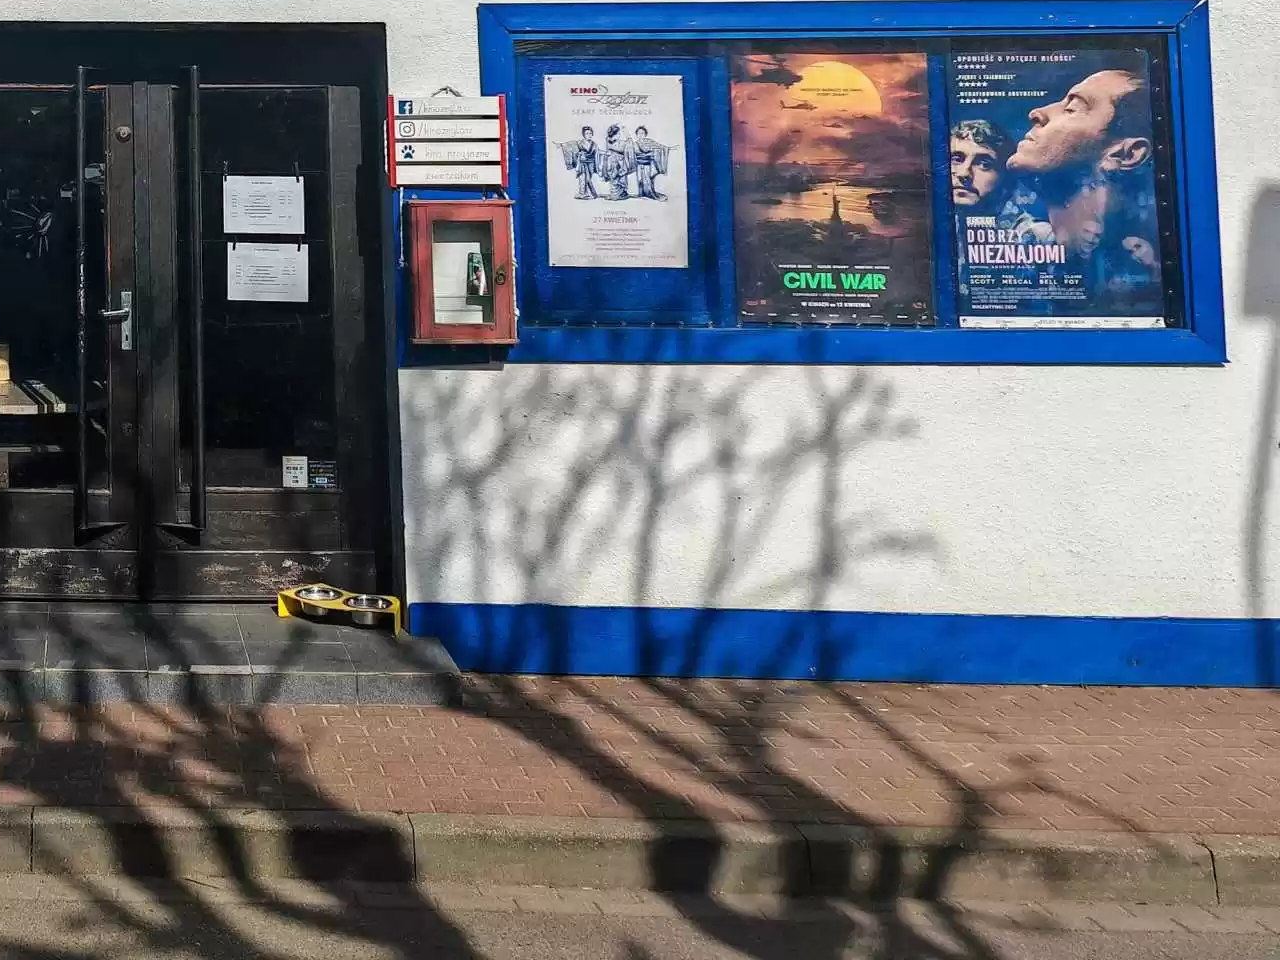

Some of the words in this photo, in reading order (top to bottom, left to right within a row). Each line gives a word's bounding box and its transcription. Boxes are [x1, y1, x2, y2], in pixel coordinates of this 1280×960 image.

[967, 229, 1023, 243] DOBRZY
[968, 244, 1066, 264] NIEZNAJOMI
[783, 272, 837, 290] CIVIL
[839, 272, 887, 290] WAR
